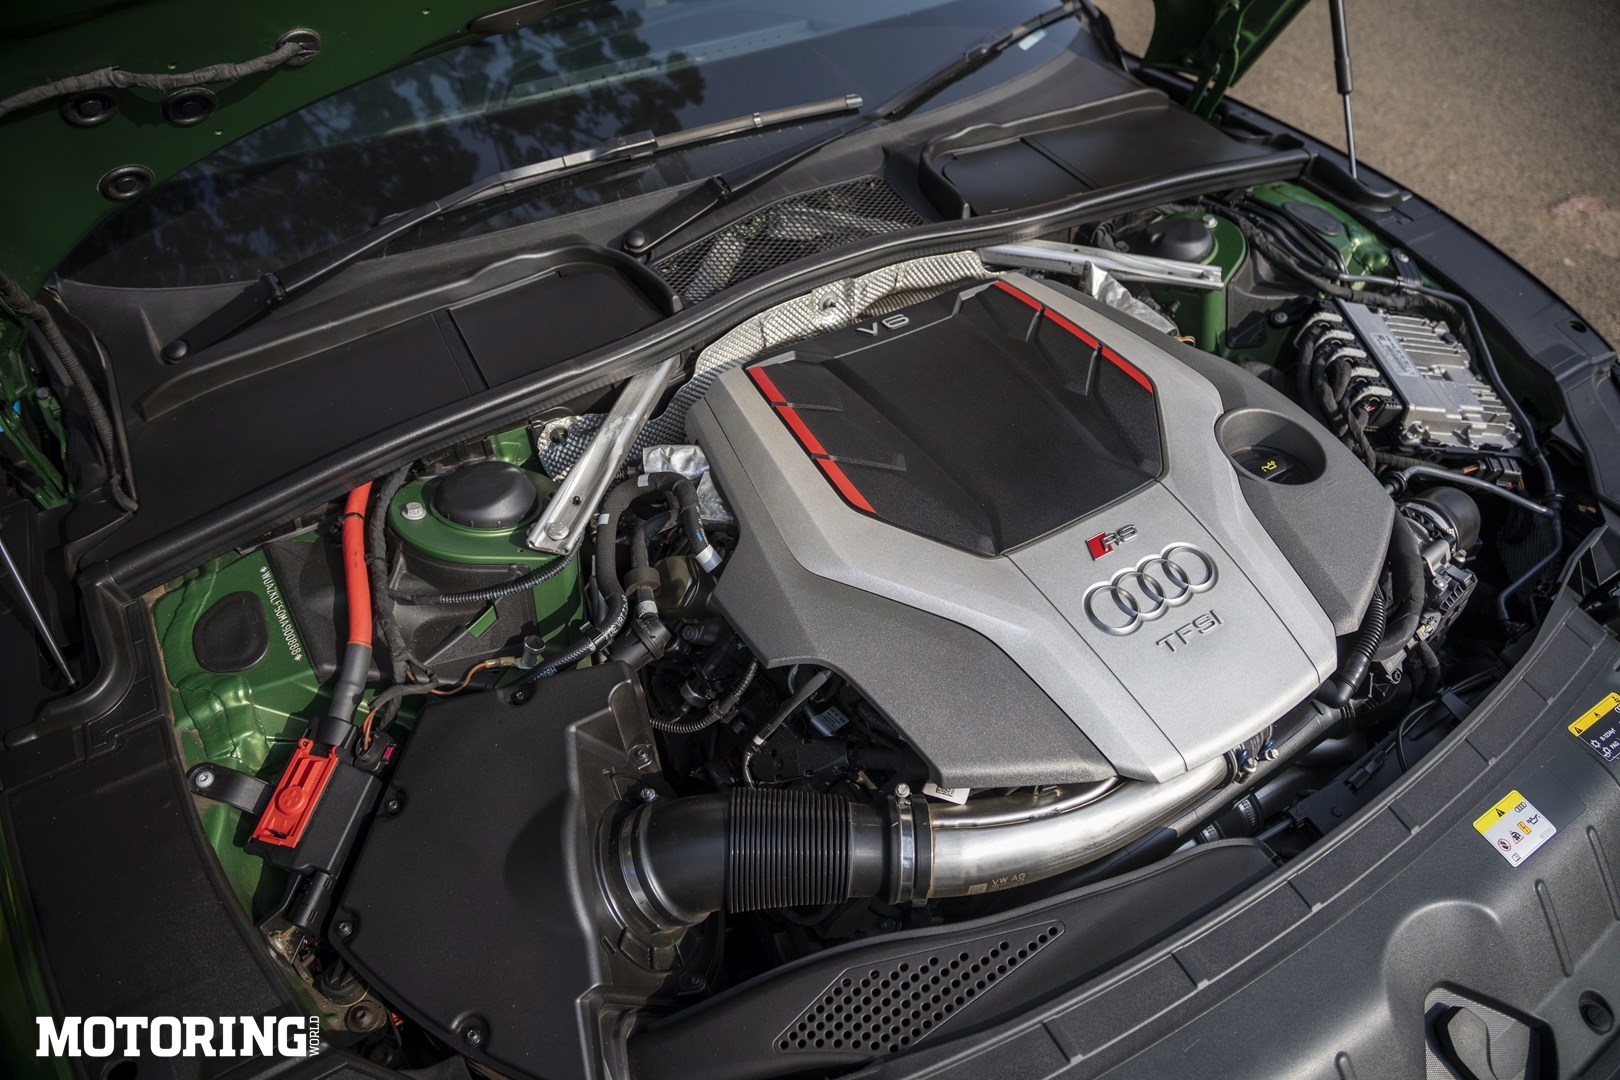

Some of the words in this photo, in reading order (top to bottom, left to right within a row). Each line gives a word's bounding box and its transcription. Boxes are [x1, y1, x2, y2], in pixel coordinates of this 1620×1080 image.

[856, 314, 910, 336] V6
[1155, 609, 1224, 653] TFSI
[991, 876, 1009, 885] VW
